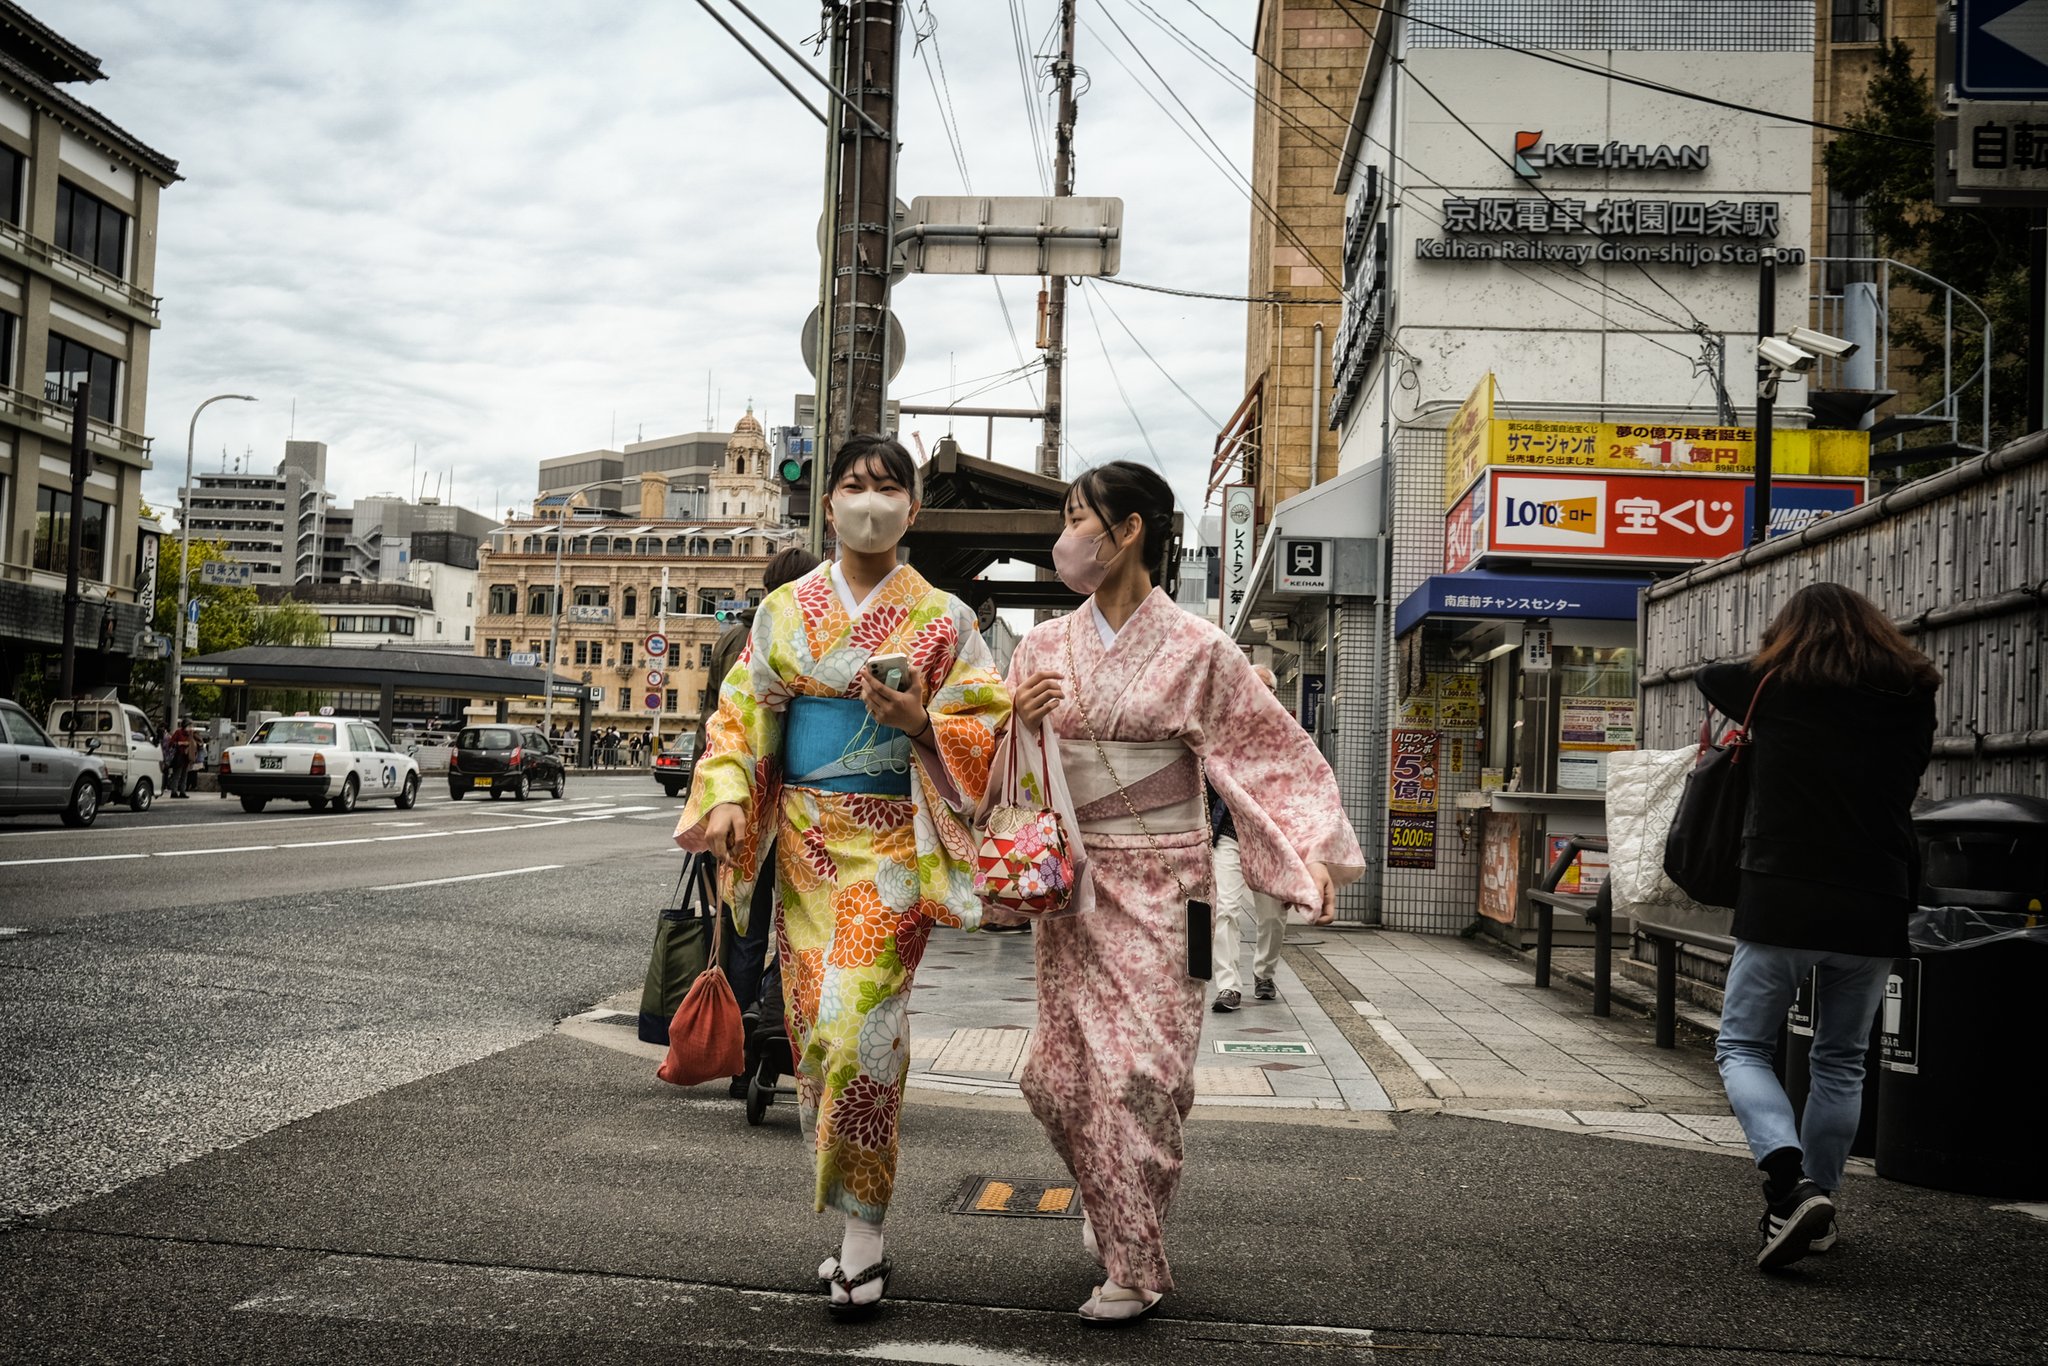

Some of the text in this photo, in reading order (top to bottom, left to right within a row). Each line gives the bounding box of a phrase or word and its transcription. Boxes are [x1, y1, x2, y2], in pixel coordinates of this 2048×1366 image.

[1545, 140, 1709, 169] KEIHAN
[1443, 198, 1779, 237] 京阪電車 祇園四条駅
[1416, 239, 1805, 267] Keihan Railway Gion-shijo Staon
[1508, 433, 1596, 454] サマージャンボ
[1616, 425, 1757, 441] 夢の億万長者誕生
[1506, 454, 1595, 465] 当売場から出ました
[1505, 497, 1557, 527] LOTO
[1569, 509, 1593, 521] ロト
[1615, 497, 1734, 536] 宝くじ
[1769, 508, 1838, 530] UMBE
[1233, 529, 1245, 584] レストラン
[1444, 595, 1580, 610] 南座前チャンスセンター
[1395, 733, 1437, 743] ハロウィン
[1398, 743, 1433, 754] ジャンボ
[1393, 754, 1422, 780] 5
[1393, 781, 1435, 804] 億円
